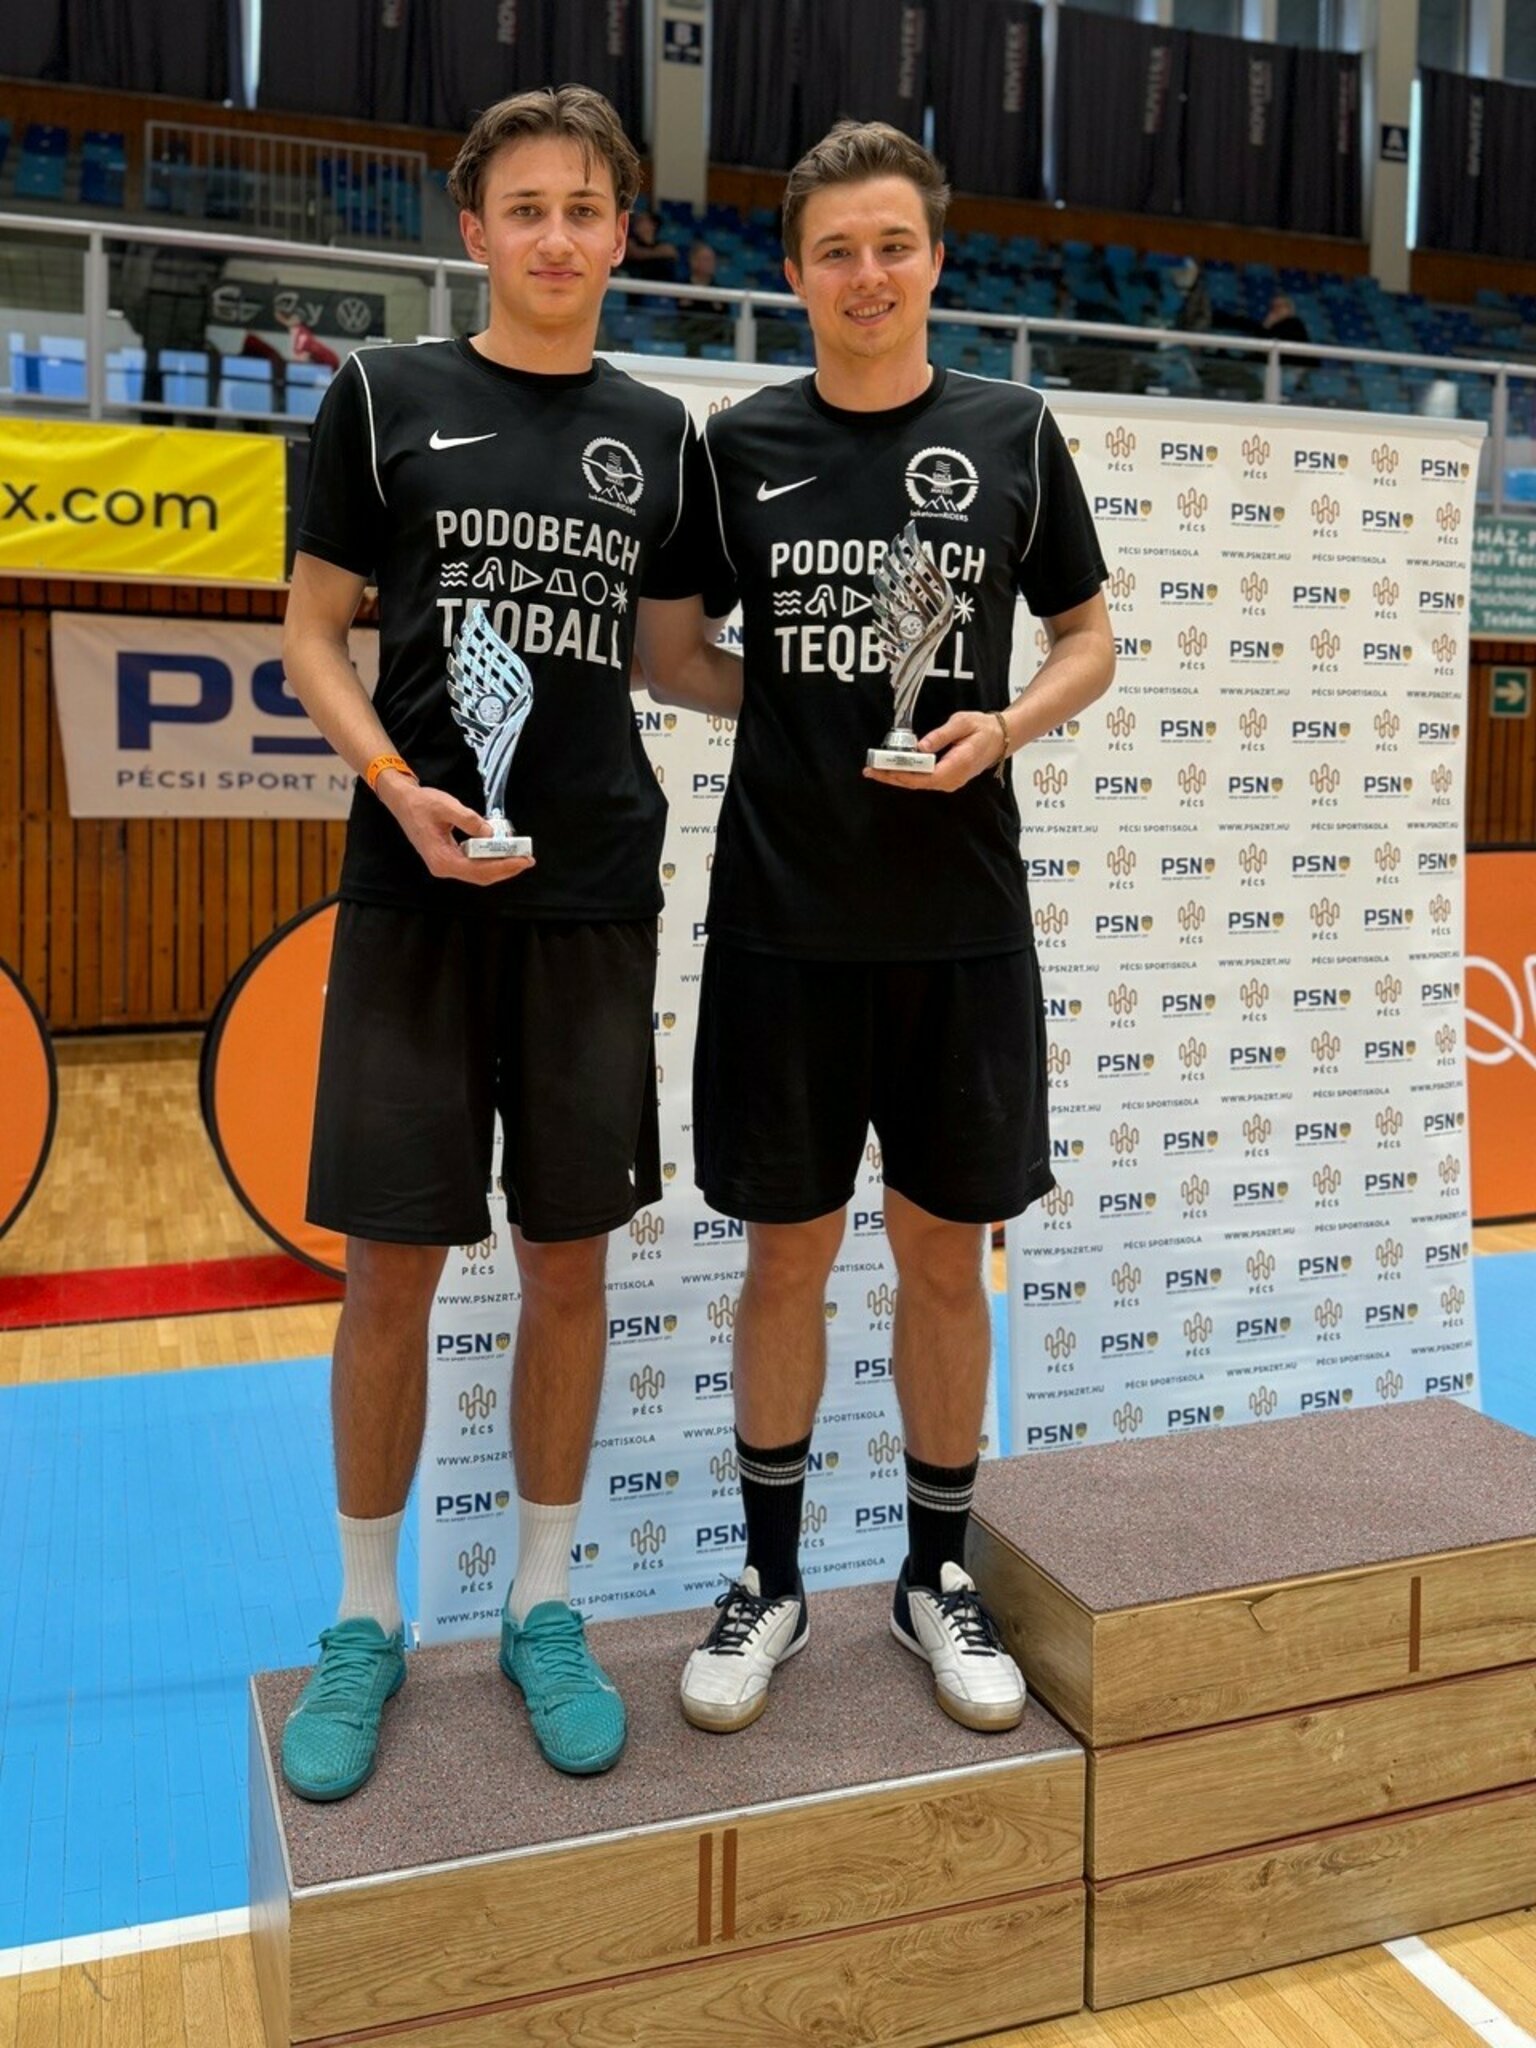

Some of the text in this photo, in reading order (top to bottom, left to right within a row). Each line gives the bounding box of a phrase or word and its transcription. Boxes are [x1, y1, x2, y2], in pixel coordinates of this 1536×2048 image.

[1160, 441, 1205, 463] PSN
[1293, 449, 1337, 470] PSN
[1107, 461, 1134, 473] PÉCS
[1093, 495, 1139, 517] PSN
[1230, 502, 1272, 523] PSN
[436, 508, 640, 576] PODOBEACH
[1312, 527, 1339, 539] PÉCS
[1159, 581, 1205, 601] PSN
[1292, 585, 1338, 604] PSN
[1241, 605, 1266, 617] PÉCS
[1229, 639, 1271, 659] PSN
[1362, 642, 1402, 661] PSN
[1179, 659, 1206, 671] PÉCS
[1291, 720, 1338, 739] PSN
[1417, 721, 1451, 740] PSN
[1108, 740, 1134, 752] PÉCS
[117, 765, 206, 789] PÉCSI
[217, 769, 316, 791] SPORT
[693, 774, 726, 793] PS
[1094, 775, 1139, 795] PSN
[1228, 775, 1270, 795] PSN
[1363, 775, 1402, 794] PSN
[1035, 797, 1066, 809] PÉCS
[1160, 856, 1203, 876] PSN
[1291, 854, 1337, 873] PSN
[1108, 879, 1135, 890] PÉCS
[1095, 914, 1140, 934] PSN
[1227, 910, 1271, 930] PSN
[1036, 937, 1067, 949] PÉCS
[1179, 934, 1204, 945] PÉCS
[1161, 993, 1203, 1013] PSN
[1293, 988, 1338, 1007] PSN
[1110, 1017, 1136, 1029] PÉCS
[1096, 1052, 1142, 1073] PSN
[1229, 1045, 1273, 1066] PSN
[1180, 1071, 1205, 1082] PÉCS
[1163, 1129, 1206, 1151] PSN
[1294, 1121, 1339, 1142] PSN
[1244, 1147, 1270, 1158] PÉCS
[1232, 1180, 1276, 1202] PSN
[1099, 1191, 1144, 1214] PSN
[1314, 1197, 1340, 1209] PÉCS
[694, 1219, 744, 1240] PSN
[854, 1211, 884, 1231] PS
[1043, 1219, 1073, 1231] PÉCS
[632, 1249, 662, 1261] PÉCS
[462, 1264, 495, 1276] PÉCS
[833, 1263, 885, 1273] ORTISKOLA
[1298, 1254, 1340, 1277] PSN
[606, 1280, 655, 1291] RTISKOLA
[1165, 1267, 1210, 1290] PSN
[437, 1292, 521, 1305] WWW.PSNZRT.
[1022, 1280, 1073, 1302] PSN
[1248, 1283, 1275, 1295] PÉCS
[1364, 1302, 1406, 1324] PSN
[609, 1316, 661, 1338] PSN
[870, 1321, 891, 1332] PÉC
[1235, 1316, 1279, 1339] PSN
[437, 1333, 493, 1354] PSN
[710, 1334, 732, 1345] PÉC
[1316, 1332, 1341, 1342] PÉCS
[1047, 1362, 1075, 1374] PÉCS
[1424, 1371, 1465, 1395] PSN
[1300, 1388, 1341, 1411] PSN
[632, 1404, 664, 1416] PÉCS
[822, 1411, 886, 1424] SPORTISKOLA
[461, 1424, 494, 1436] PÉCS
[1026, 1422, 1074, 1440] PSN
[610, 1471, 662, 1495] PSN
[870, 1468, 899, 1479] PÉCS
[711, 1486, 742, 1498] PÉCS
[436, 1492, 491, 1517] PSN
[855, 1504, 904, 1527] PSN
[696, 1523, 747, 1548] PSN
[633, 1559, 664, 1571] PÉCS
[821, 1556, 886, 1576] SPORTISKOLA
[461, 1581, 494, 1594] PÉCS
[588, 1588, 656, 1607] SPORTISKOLA
